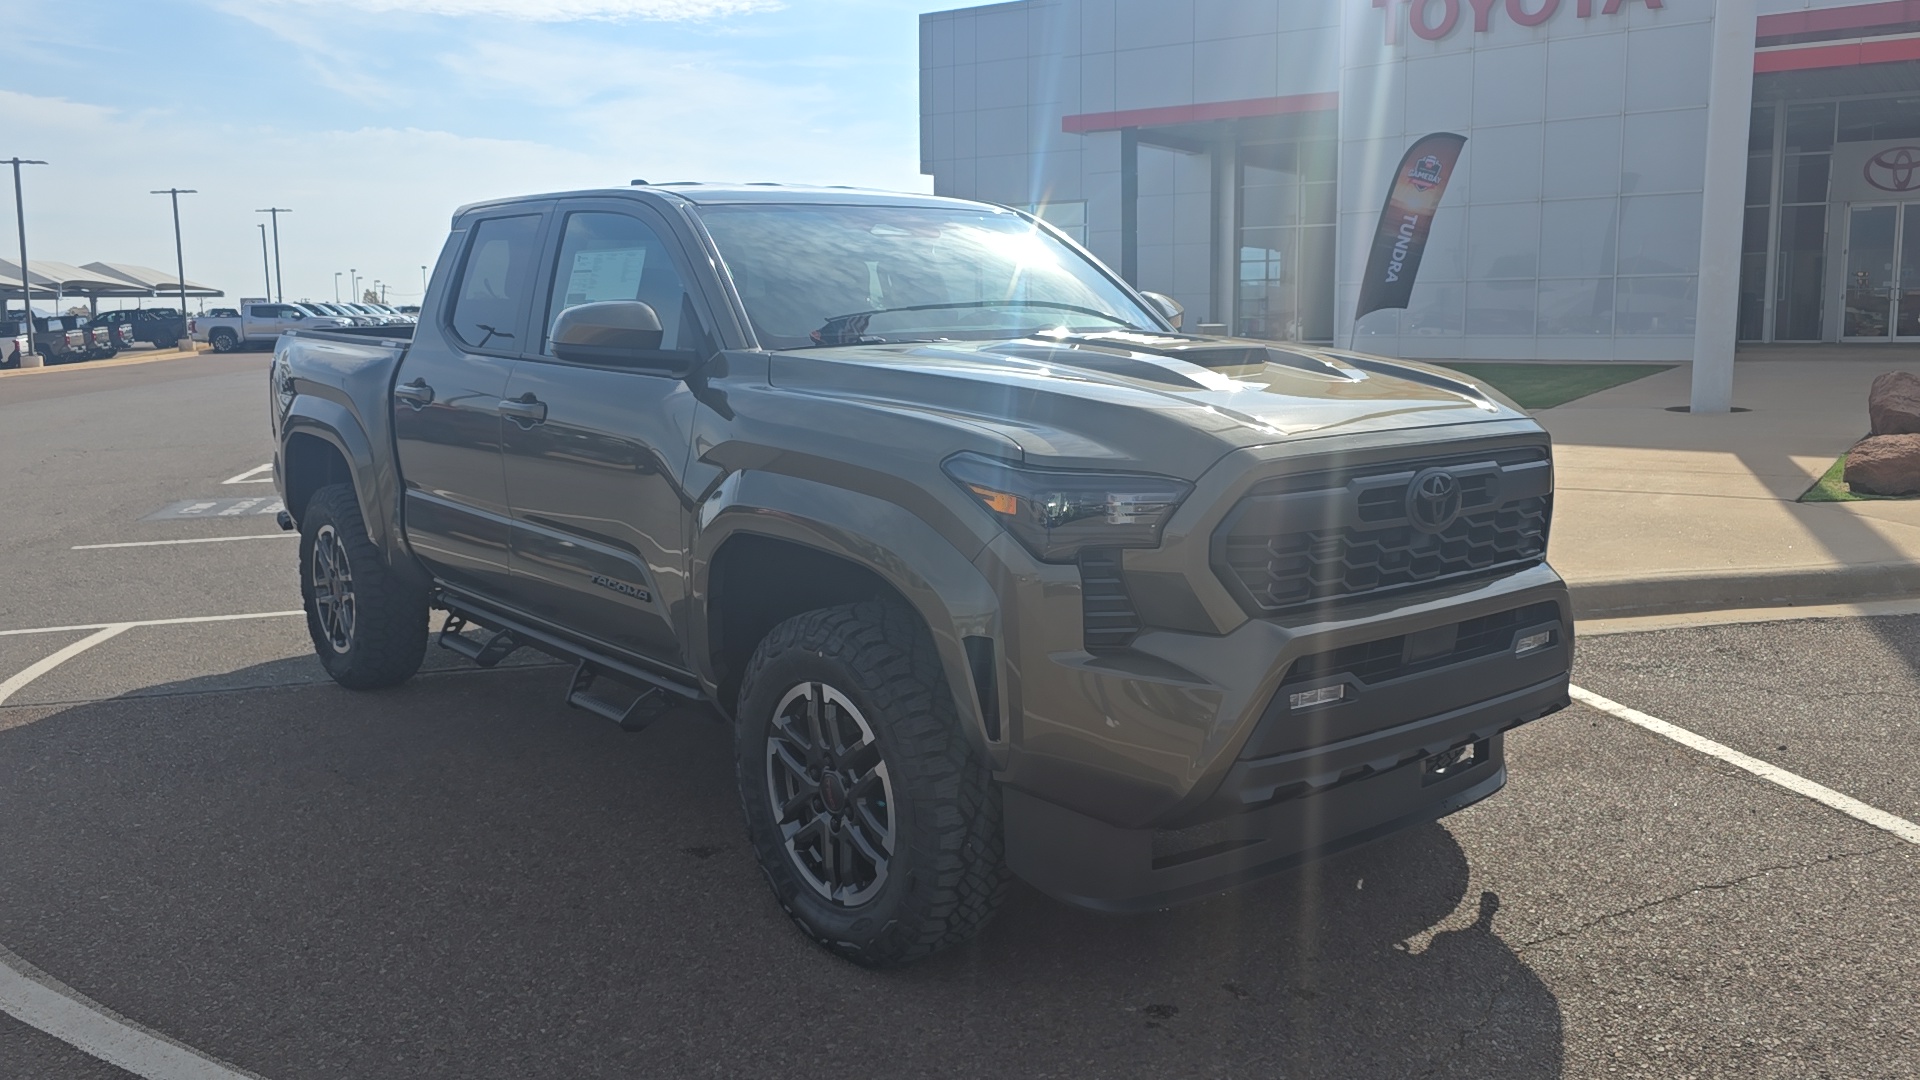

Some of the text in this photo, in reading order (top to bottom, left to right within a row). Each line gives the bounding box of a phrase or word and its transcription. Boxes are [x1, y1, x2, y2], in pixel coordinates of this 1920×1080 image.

[1407, 169, 1442, 185] GAMEDAY
[1385, 214, 1418, 283] TUNDRA
[591, 574, 651, 602] TACOMA
